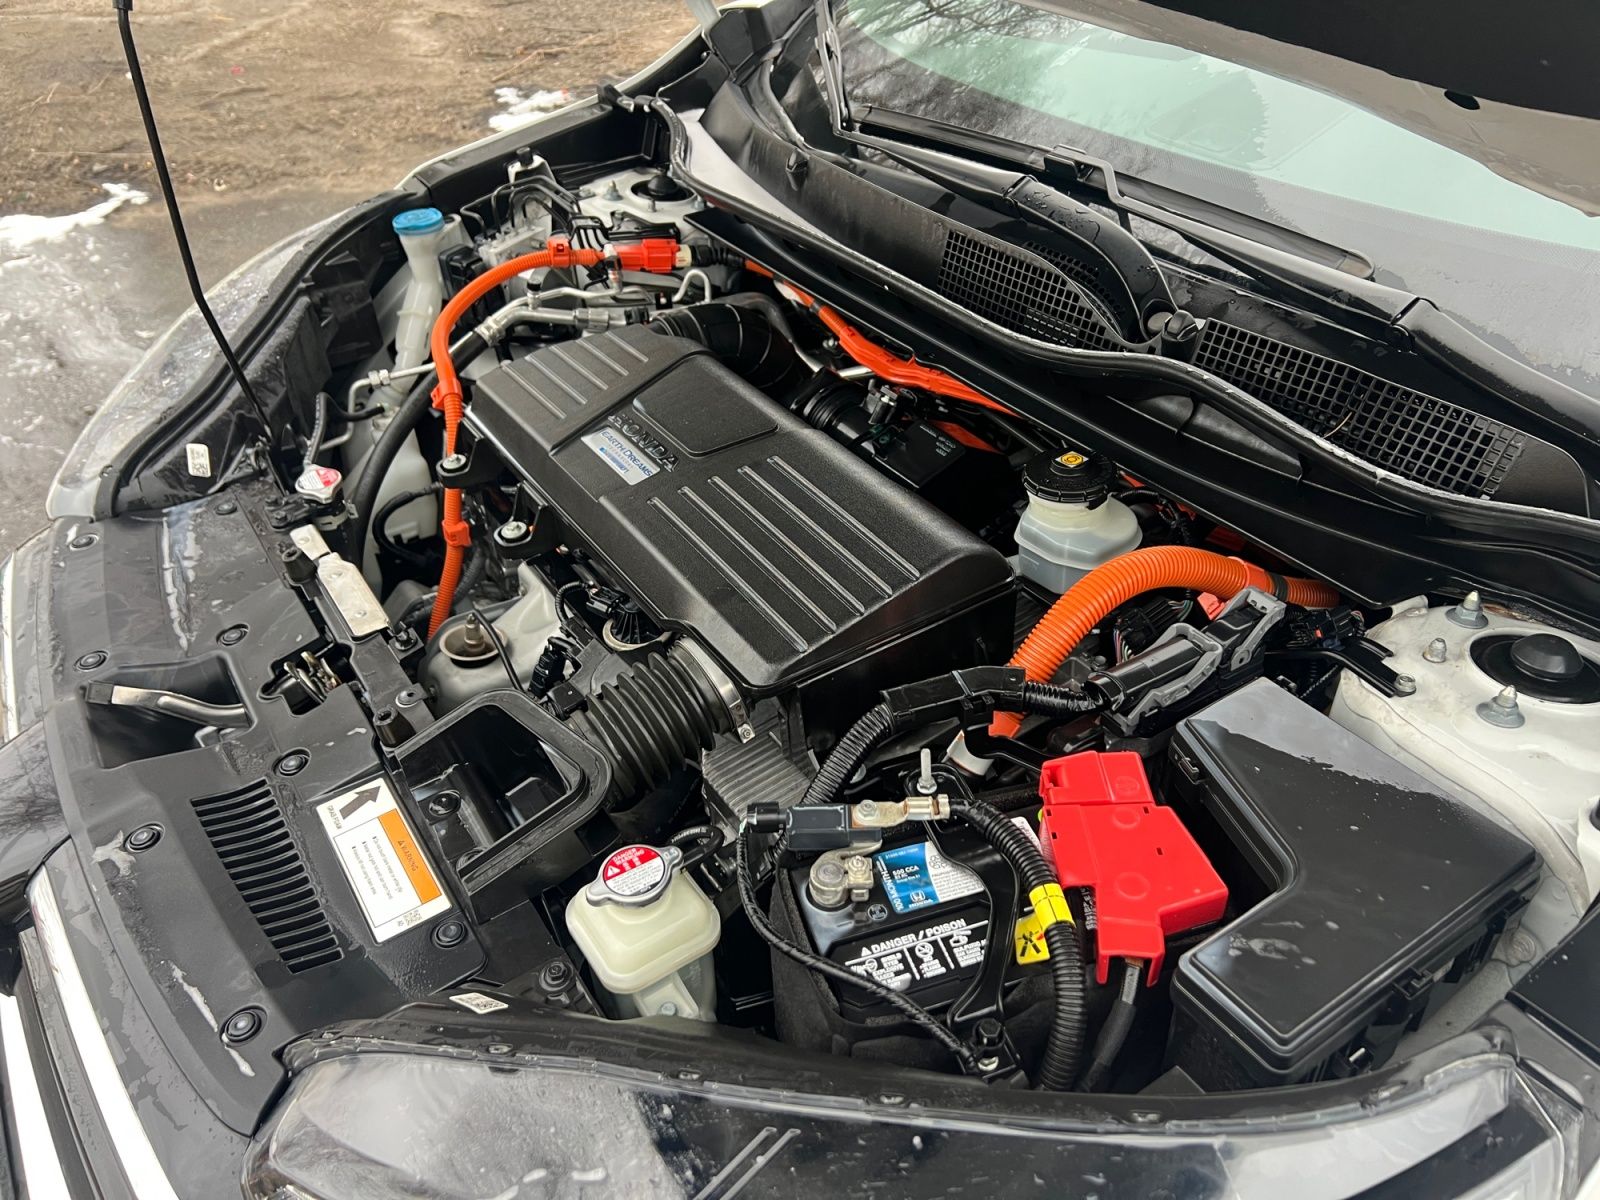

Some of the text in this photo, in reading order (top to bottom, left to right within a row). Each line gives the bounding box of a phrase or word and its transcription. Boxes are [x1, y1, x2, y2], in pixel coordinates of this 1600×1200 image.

[601, 430, 626, 454] EARTH
[623, 448, 654, 477] DREAMS
[608, 413, 679, 473] HONDA
[870, 933, 917, 954] DANGER
[925, 918, 967, 938] POISON
